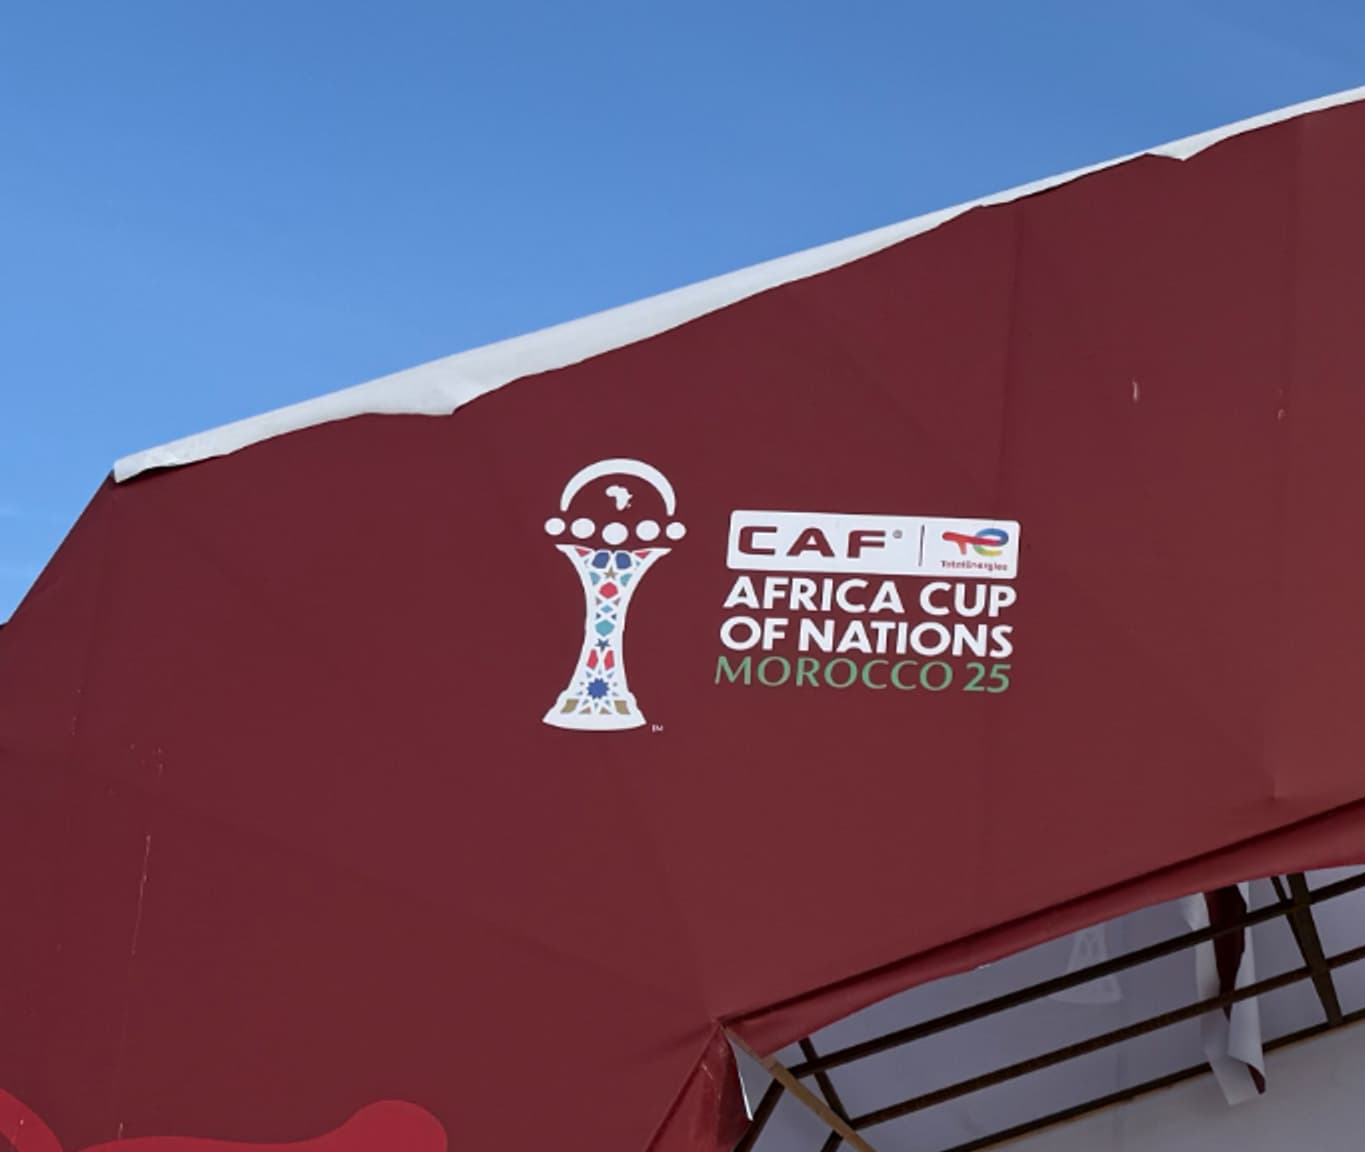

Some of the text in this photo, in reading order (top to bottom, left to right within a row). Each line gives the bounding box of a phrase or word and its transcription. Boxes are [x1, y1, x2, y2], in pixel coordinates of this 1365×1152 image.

[723, 576, 1017, 618] AFRICA CUP
[719, 615, 1014, 659] OF NATIONS
[714, 655, 1010, 692] MOROCCO 25
